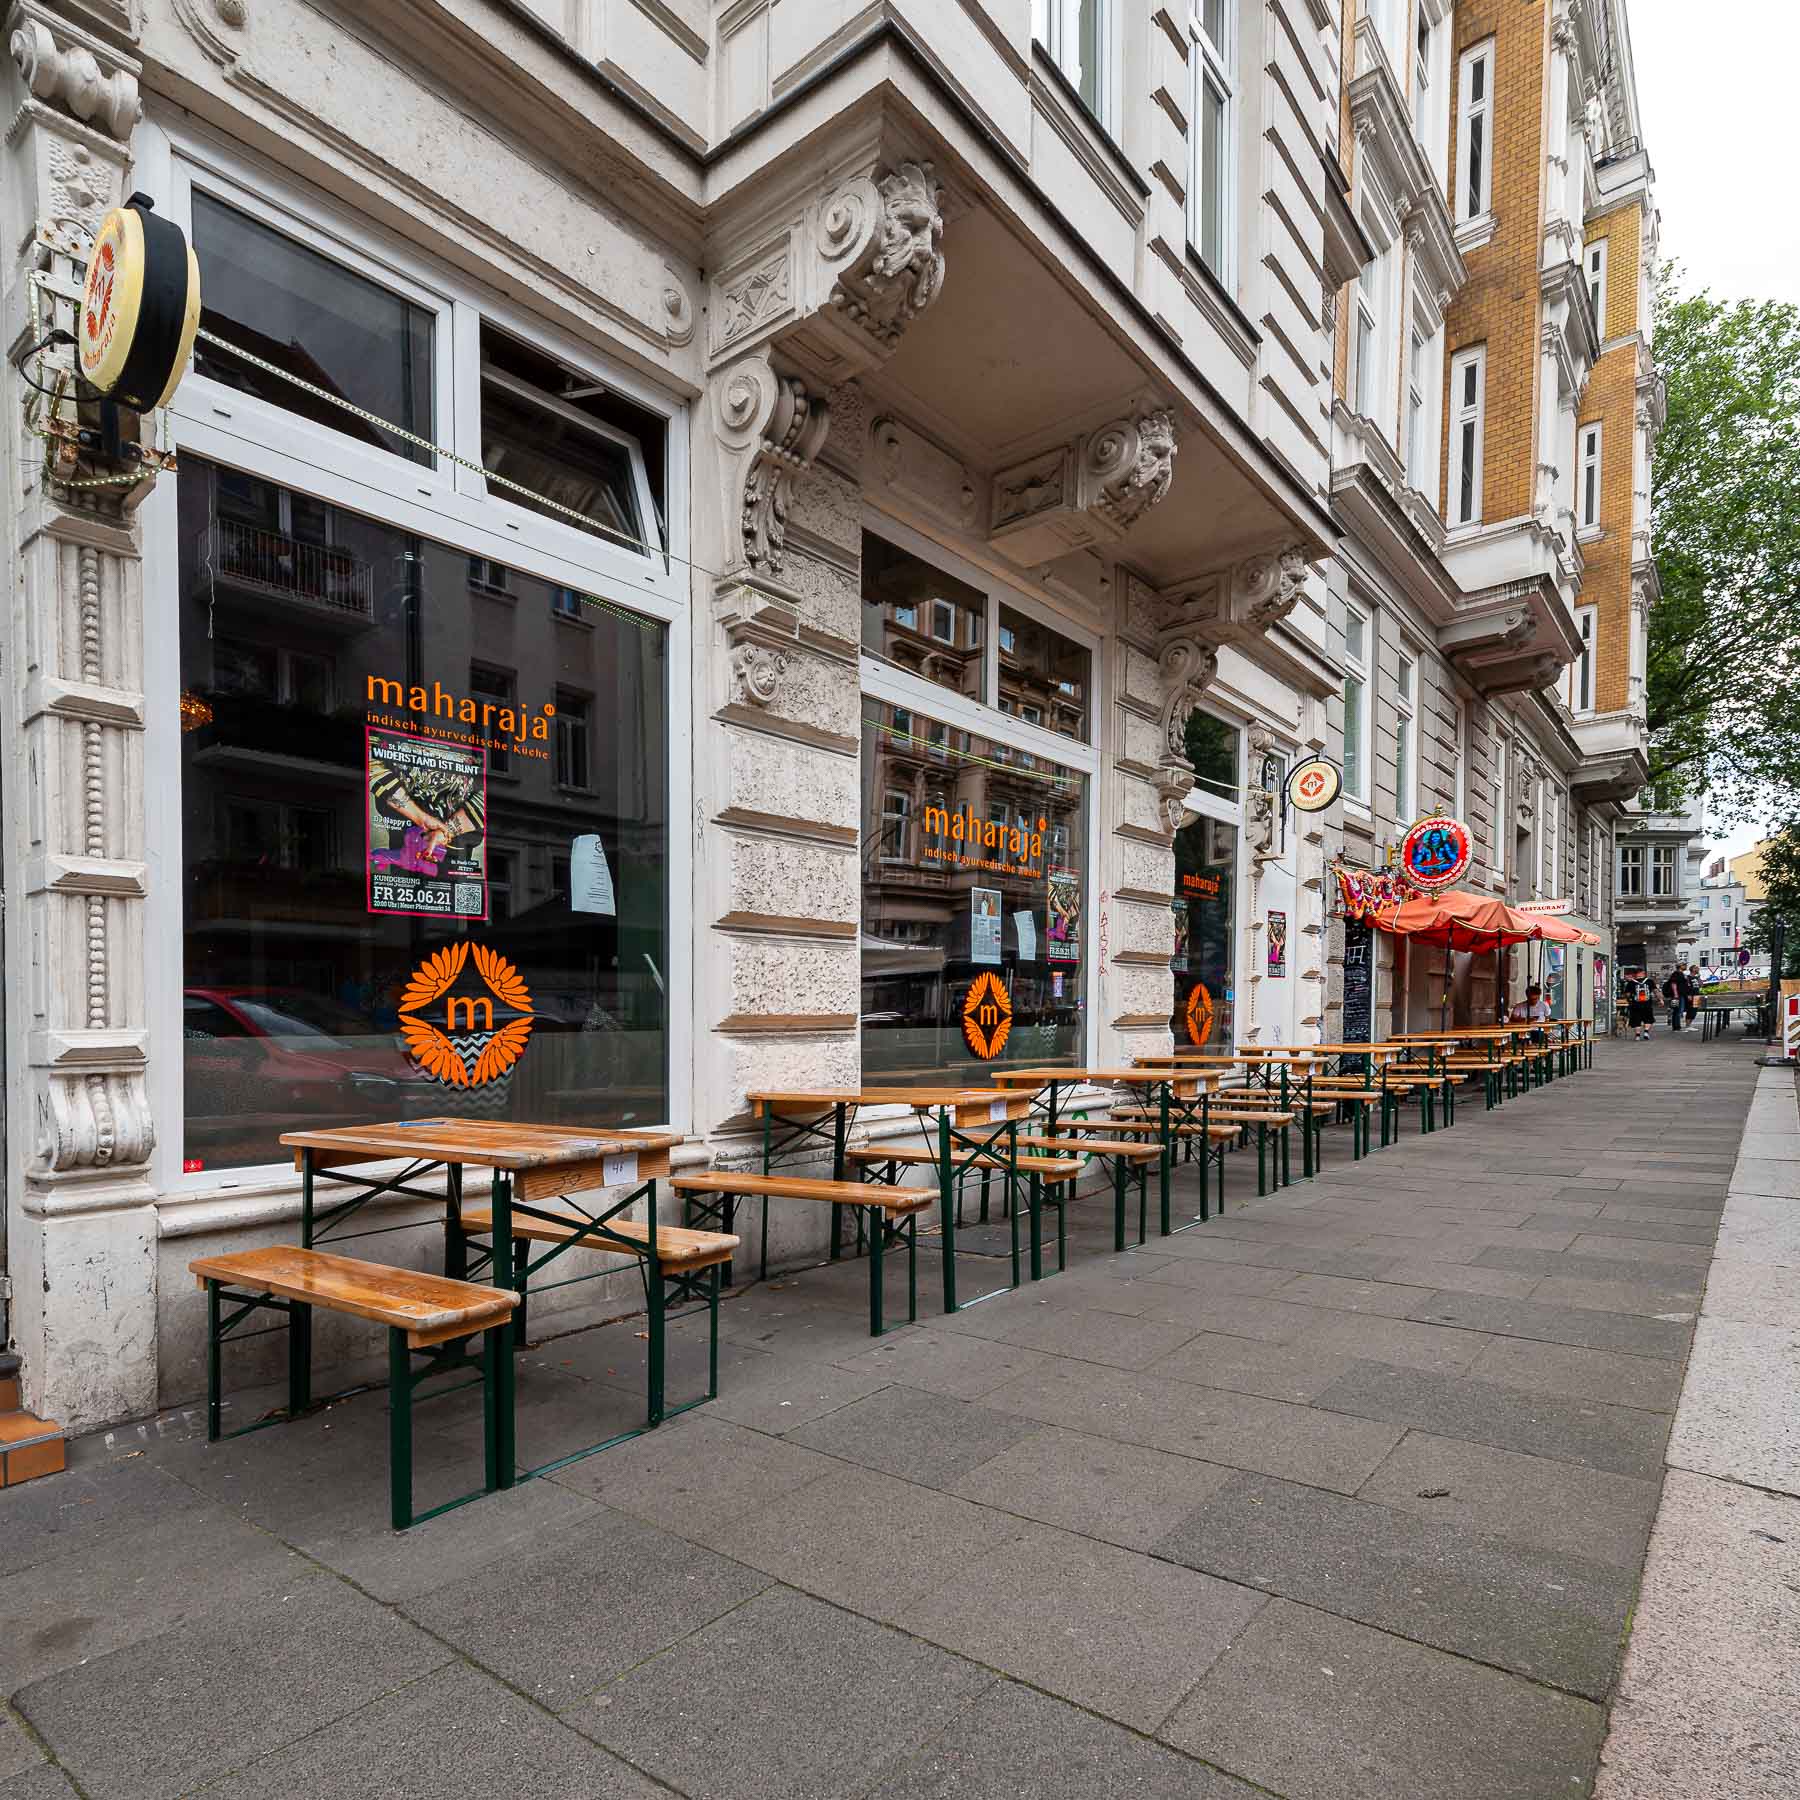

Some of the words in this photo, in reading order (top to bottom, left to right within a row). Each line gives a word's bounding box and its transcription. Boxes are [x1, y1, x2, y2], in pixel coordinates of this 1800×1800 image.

[368, 675, 548, 742] maharaja
[367, 711, 418, 731] indisch
[423, 723, 509, 751] ayurvedische
[513, 744, 549, 760] Küche
[373, 747, 437, 768] WIDERSTAND
[438, 760, 454, 770] IST
[455, 763, 480, 775] BUNT
[924, 803, 1041, 862] maharaja
[1413, 823, 1457, 840] maharaja
[924, 847, 958, 862] indisch
[960, 855, 1016, 873] ayurvedische
[373, 874, 421, 885] KUNDGEBUNG
[1183, 873, 1219, 895] maharaja
[373, 886, 394, 900] FR
[397, 888, 452, 905] 25.06.21
[1520, 904, 1566, 912] RESTAURANT
[447, 996, 493, 1030] m
[980, 1004, 998, 1025] m
